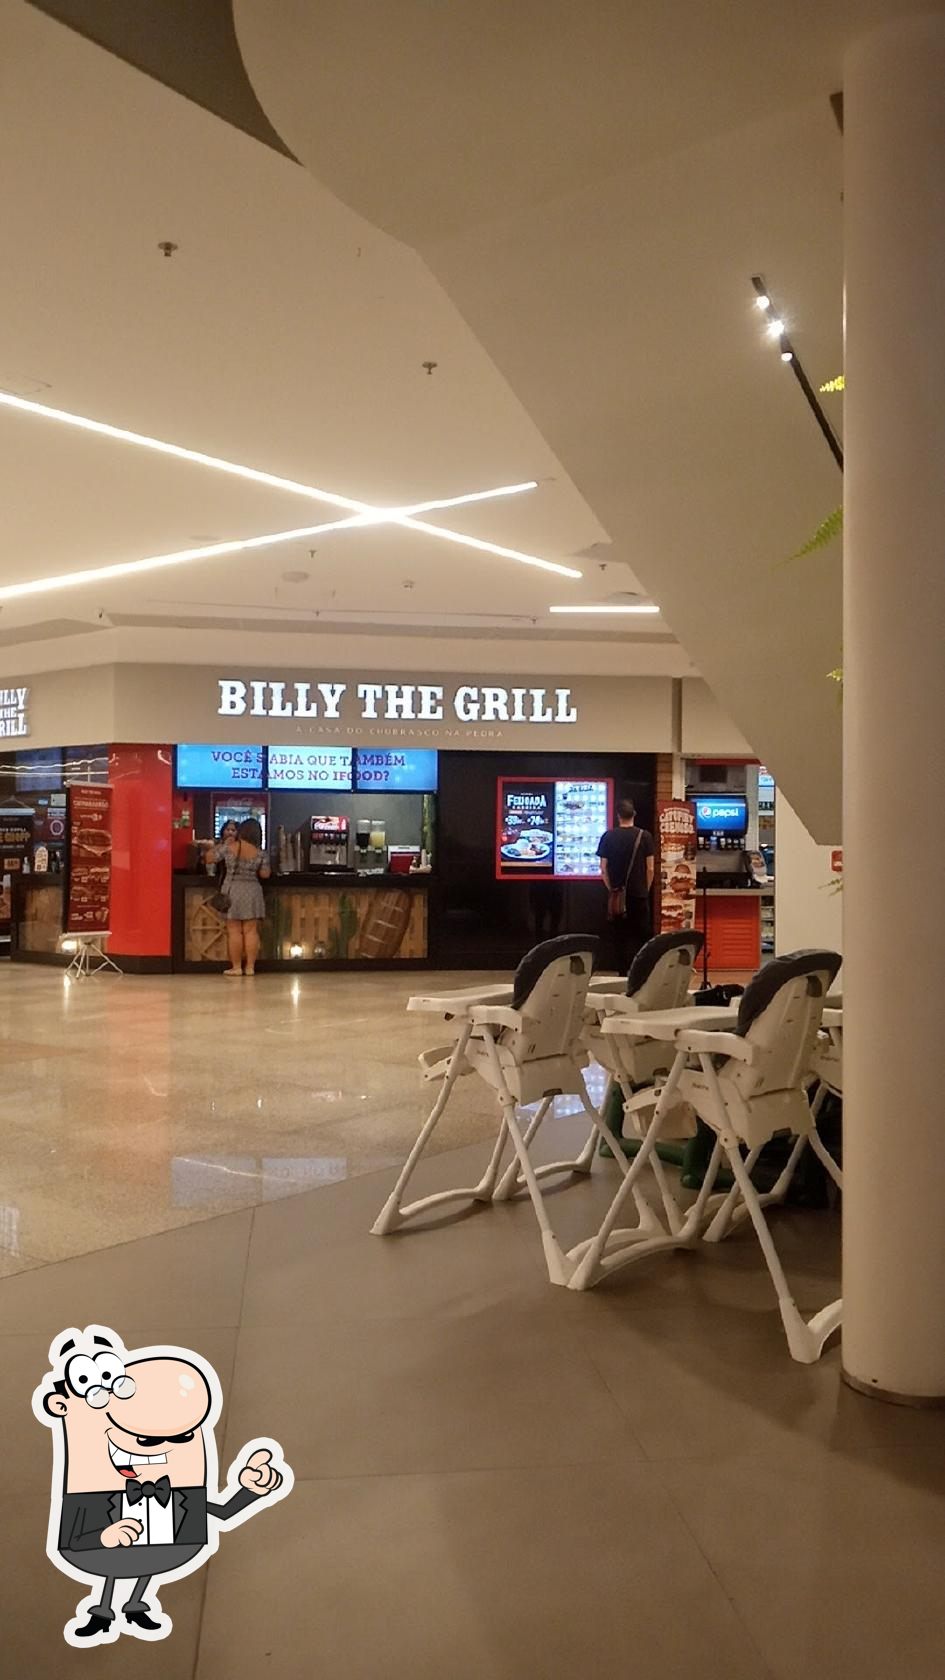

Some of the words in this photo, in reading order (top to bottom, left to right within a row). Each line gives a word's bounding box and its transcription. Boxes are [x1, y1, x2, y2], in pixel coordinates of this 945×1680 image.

[217, 680, 346, 718] BILLY
[357, 684, 444, 720] THE
[453, 686, 577, 723] GRILL
[346, 727, 363, 735] DO
[211, 750, 252, 763] VOCÊ
[307, 754, 337, 766] QUE
[339, 753, 406, 767] TAMBÉM
[231, 767, 304, 781] ESTAMOS
[307, 770, 329, 781] NO
[332, 770, 390, 782] IFOOD?
[712, 807, 739, 819] pepsi
